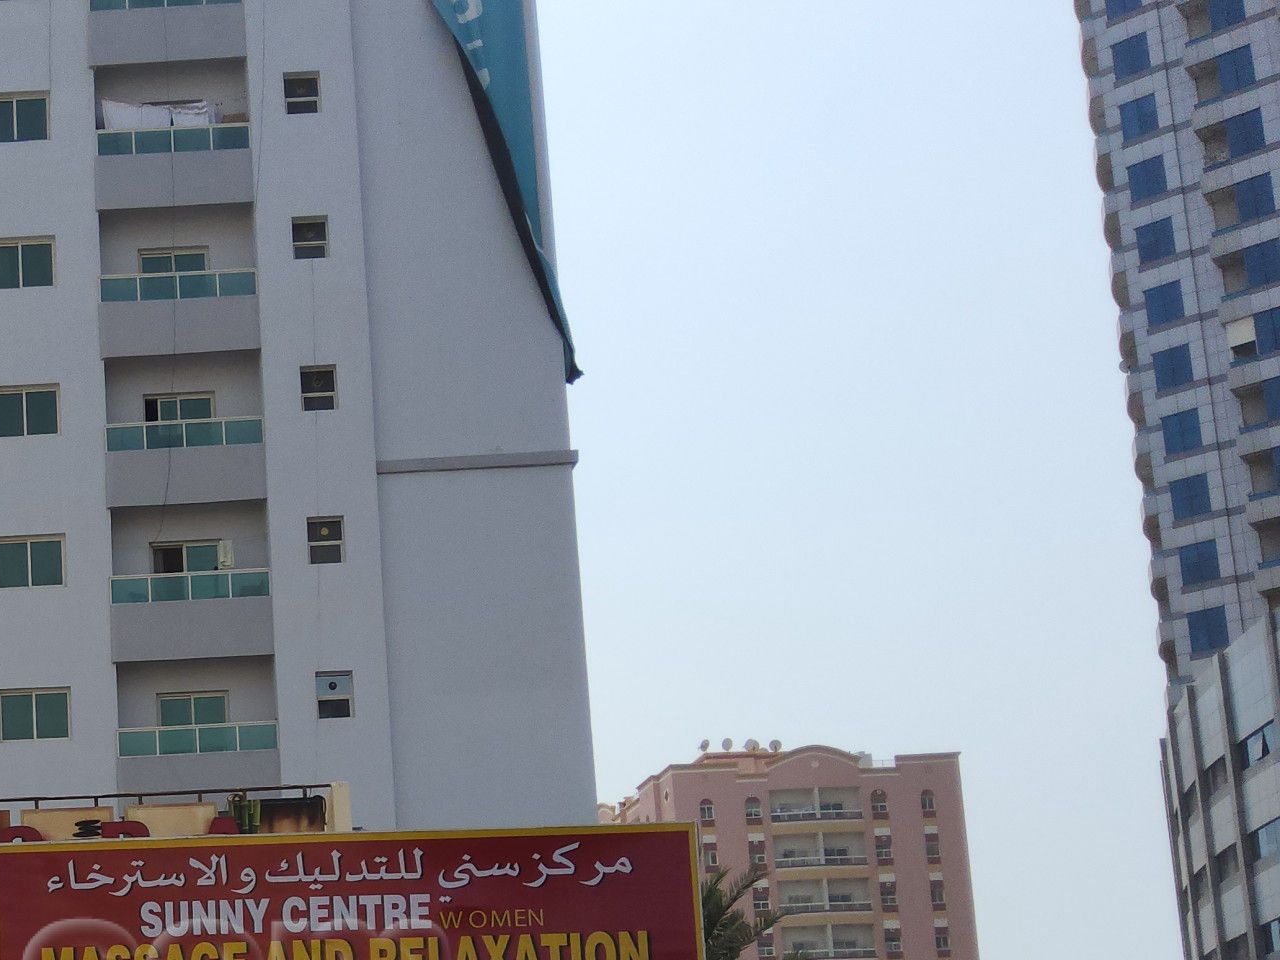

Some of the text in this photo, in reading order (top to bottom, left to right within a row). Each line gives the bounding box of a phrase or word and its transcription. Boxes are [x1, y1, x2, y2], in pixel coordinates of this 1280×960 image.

[265, 848, 424, 890] للتدليك
[522, 842, 634, 887] مركز
[140, 893, 432, 938] SUNNY CENTRE
[439, 907, 545, 930] WOMEN
